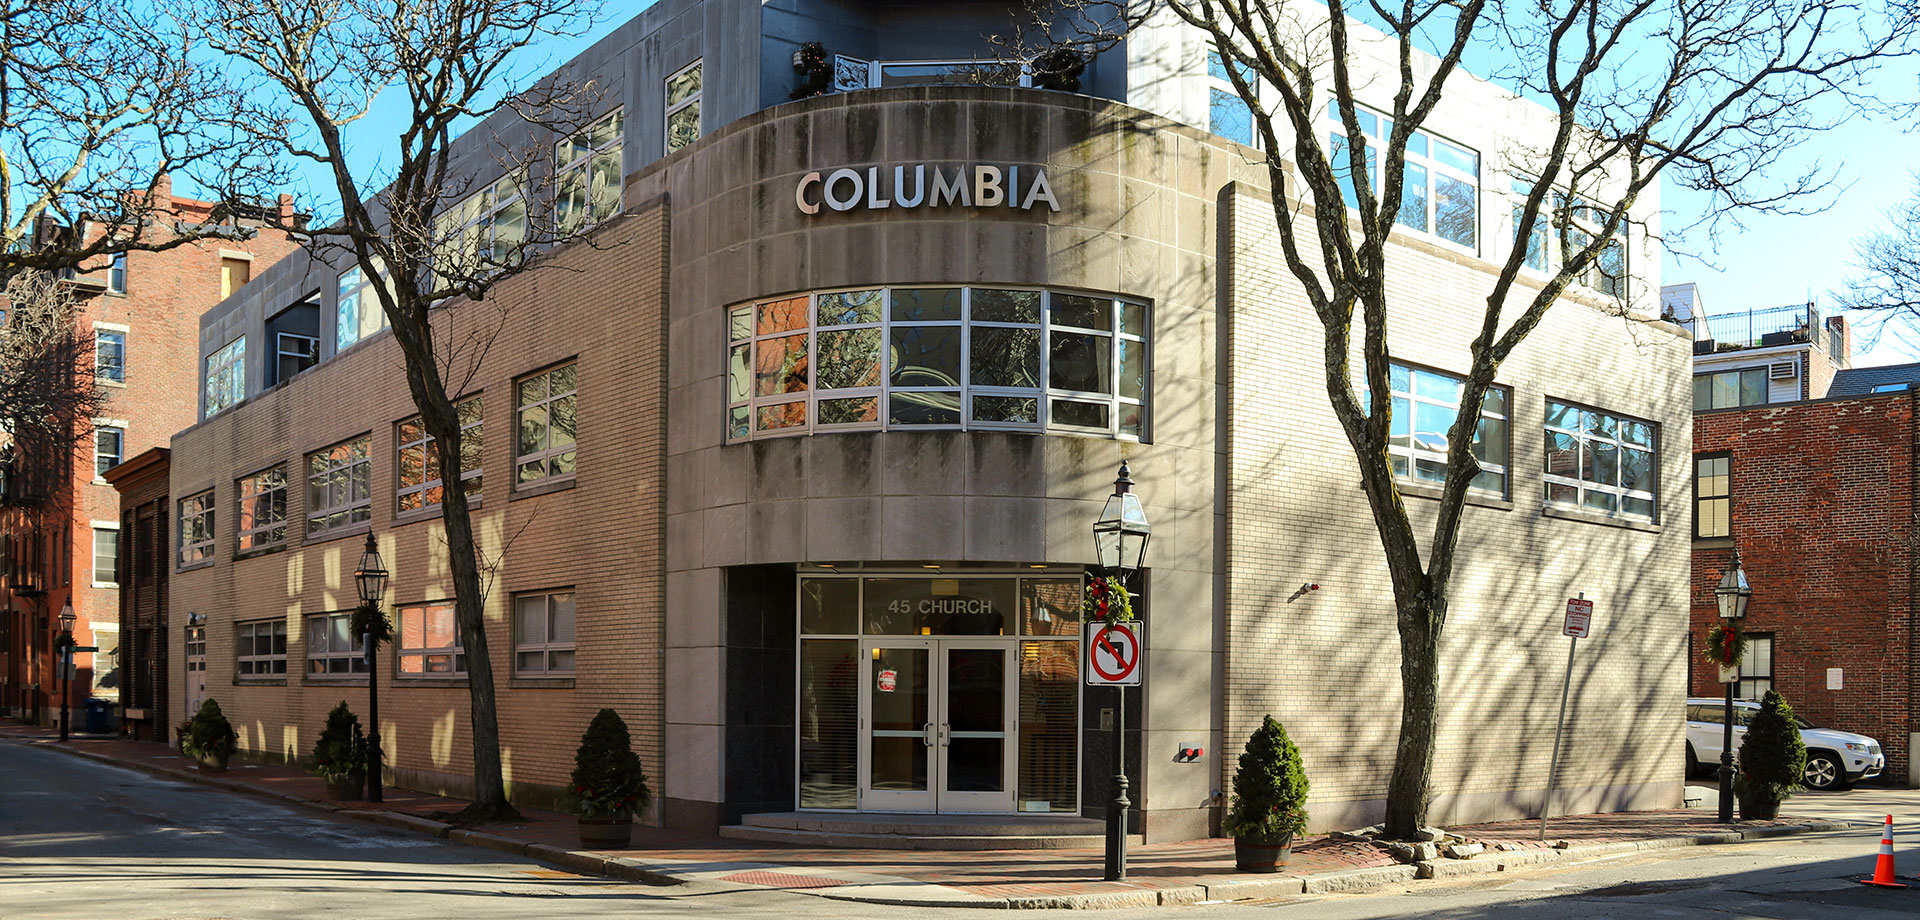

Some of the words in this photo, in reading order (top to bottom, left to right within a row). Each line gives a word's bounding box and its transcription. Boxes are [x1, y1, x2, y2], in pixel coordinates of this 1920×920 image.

[796, 164, 1061, 214] COLUMBIA
[888, 600, 911, 614] 45
[918, 600, 992, 614] CHURCH
